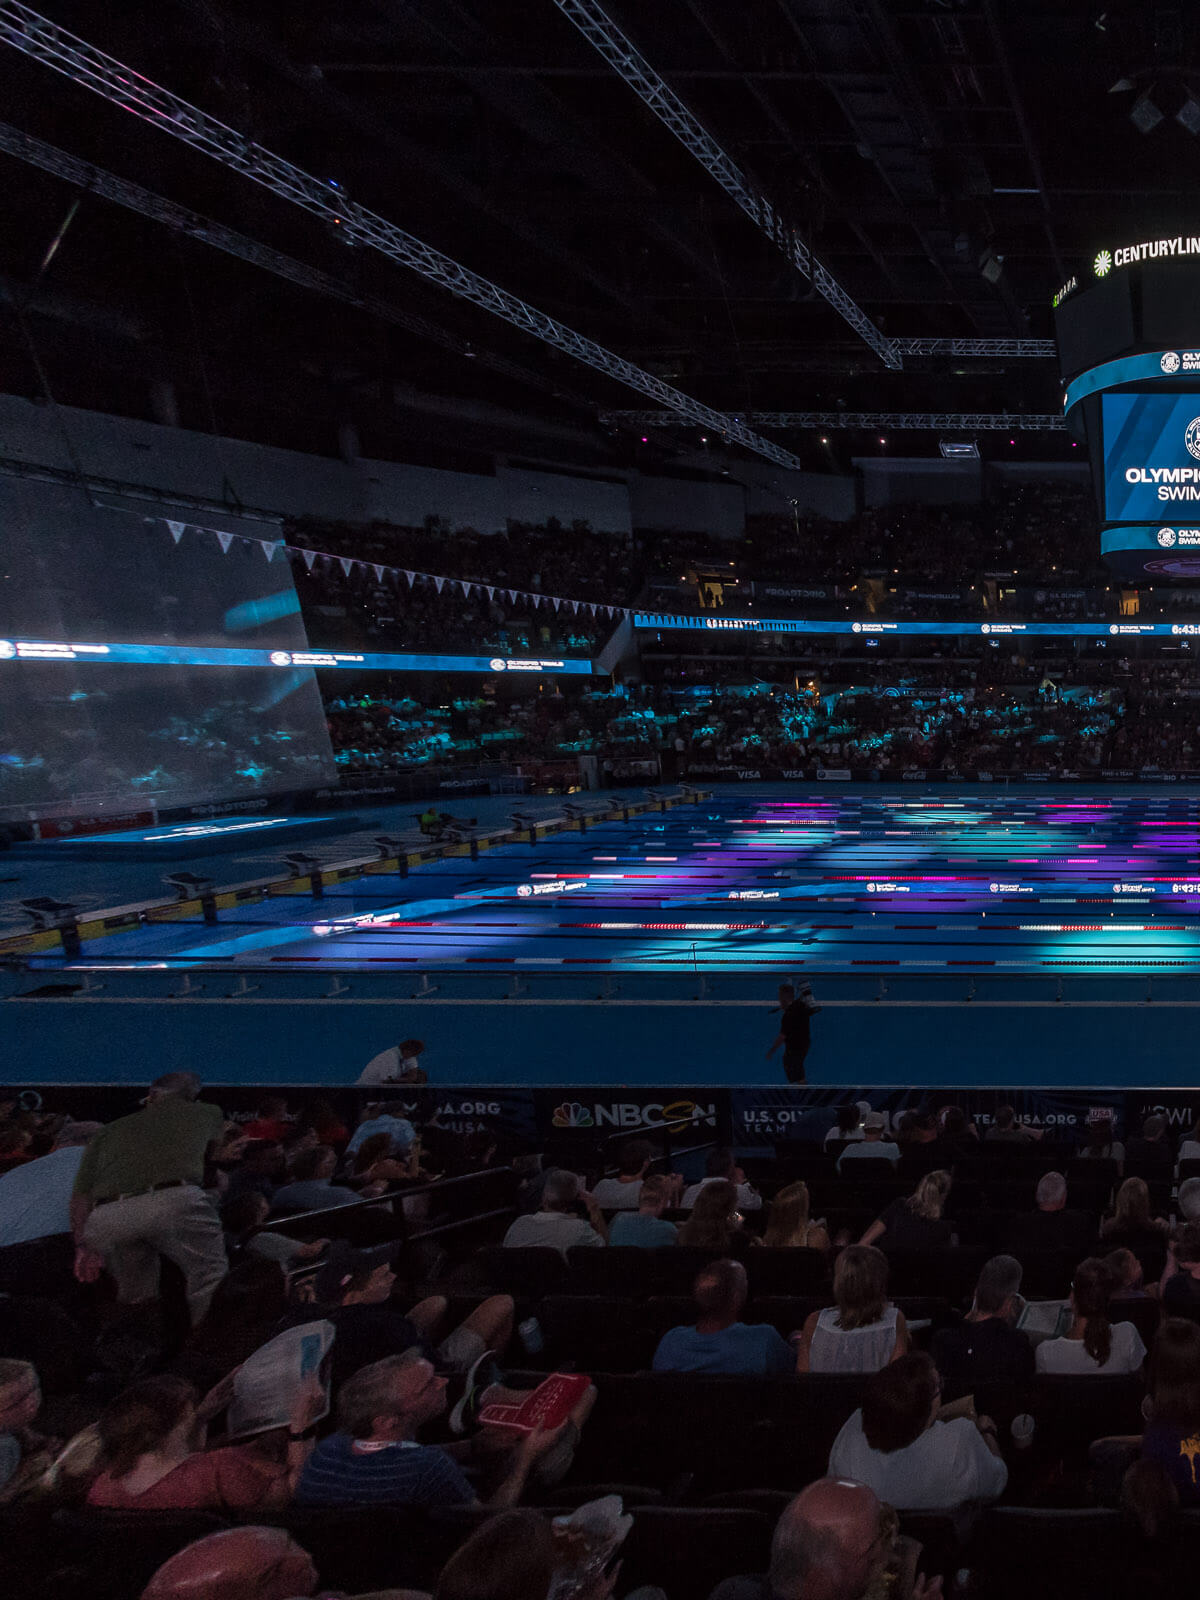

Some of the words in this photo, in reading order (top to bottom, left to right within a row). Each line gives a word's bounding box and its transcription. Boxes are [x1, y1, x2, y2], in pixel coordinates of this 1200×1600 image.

[736, 770, 760, 779] VISA
[782, 770, 804, 778] VISA
[594, 1101, 717, 1133] NBCSN
[743, 1124, 787, 1133] TEAM
